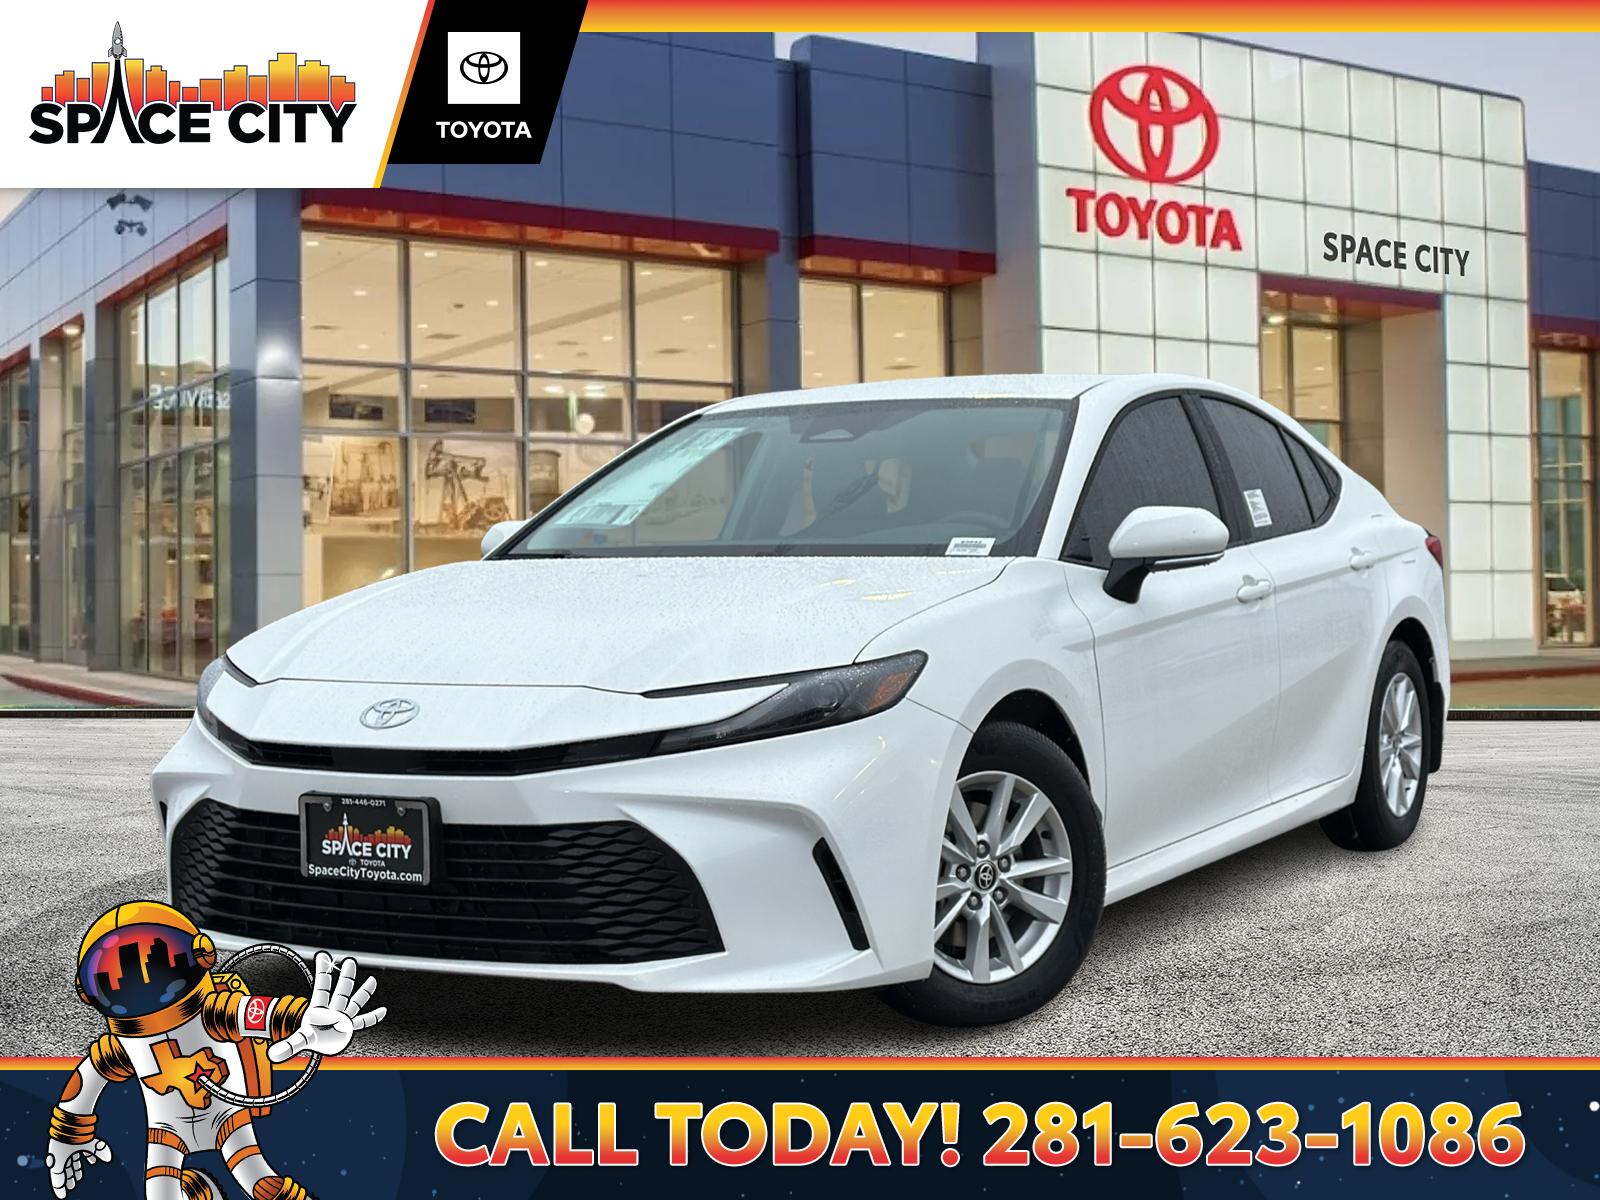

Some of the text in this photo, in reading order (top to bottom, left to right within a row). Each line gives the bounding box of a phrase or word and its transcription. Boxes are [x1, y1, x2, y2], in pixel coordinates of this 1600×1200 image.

[1066, 187, 1242, 251] TOYOTA
[1323, 232, 1470, 277] SPACE CITY
[321, 839, 412, 860] SPACE CITY
[308, 863, 423, 882] SpaceCityToyota.com
[360, 858, 386, 867] TOYOTA
